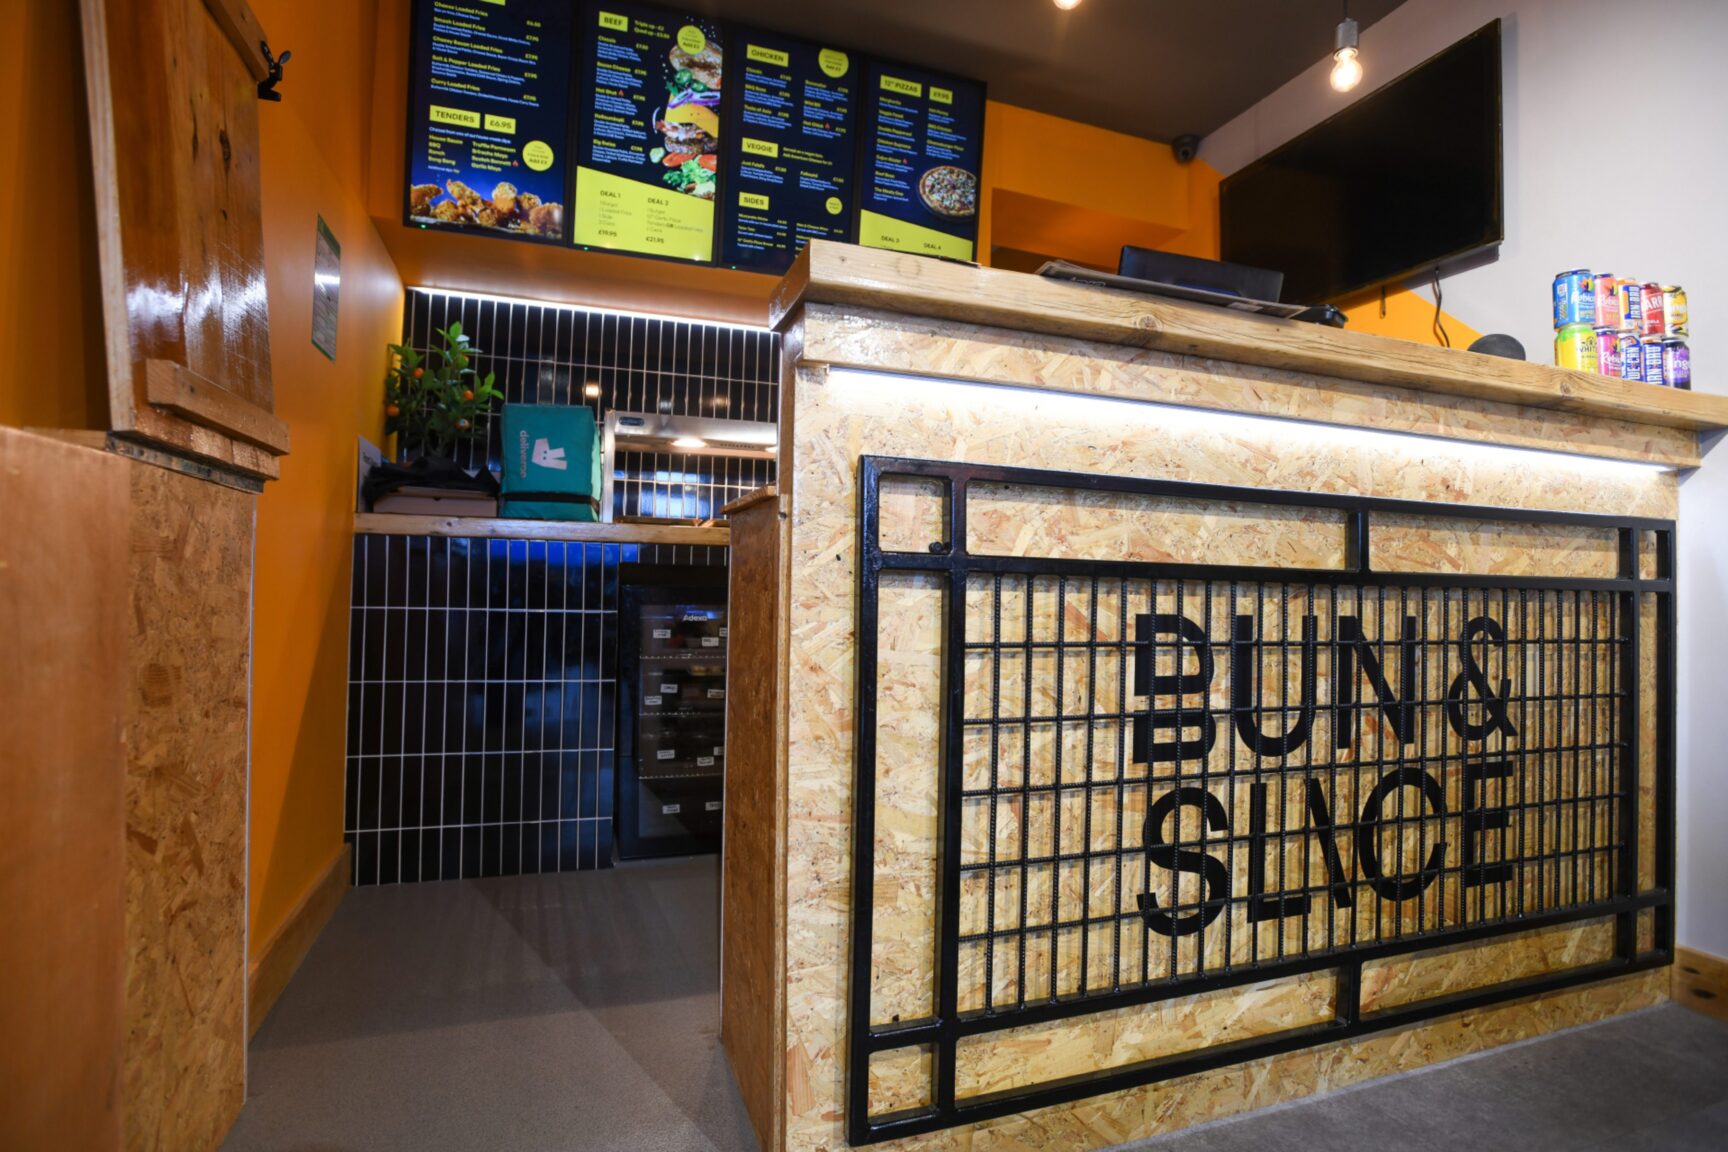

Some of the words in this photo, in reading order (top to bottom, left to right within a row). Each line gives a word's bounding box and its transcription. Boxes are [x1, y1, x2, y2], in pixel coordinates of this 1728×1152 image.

[456, 5, 474, 13] Loaded
[475, 9, 488, 17] Fries
[453, 20, 472, 28] Loaded
[472, 24, 486, 32] Fries
[604, 16, 623, 26] BEEF
[470, 42, 490, 51] Loaded
[490, 46, 503, 54] Fries
[752, 49, 784, 62] CHICKEN
[449, 58, 468, 66] Pepper
[468, 61, 488, 70] Loaded
[431, 78, 446, 86] Curry
[447, 81, 466, 89] Loaded
[467, 84, 480, 92] Fries
[895, 81, 918, 93] PIZZAS
[436, 110, 474, 123] TENDERS
[490, 120, 512, 129] £6.95
[490, 144, 516, 153] Parmesan
[746, 142, 773, 152] VEGGIE
[600, 190, 617, 198] DEAL
[648, 197, 664, 206] DEAL
[744, 196, 764, 206] SIDES
[924, 242, 937, 250] DEAL
[1646, 346, 1662, 384] IRN-BRU
[519, 430, 530, 479] deliveroo
[682, 614, 708, 622] Adexa
[1133, 614, 1416, 763] BUN
[1447, 616, 1518, 741] &
[1137, 760, 1514, 937] SLICE
